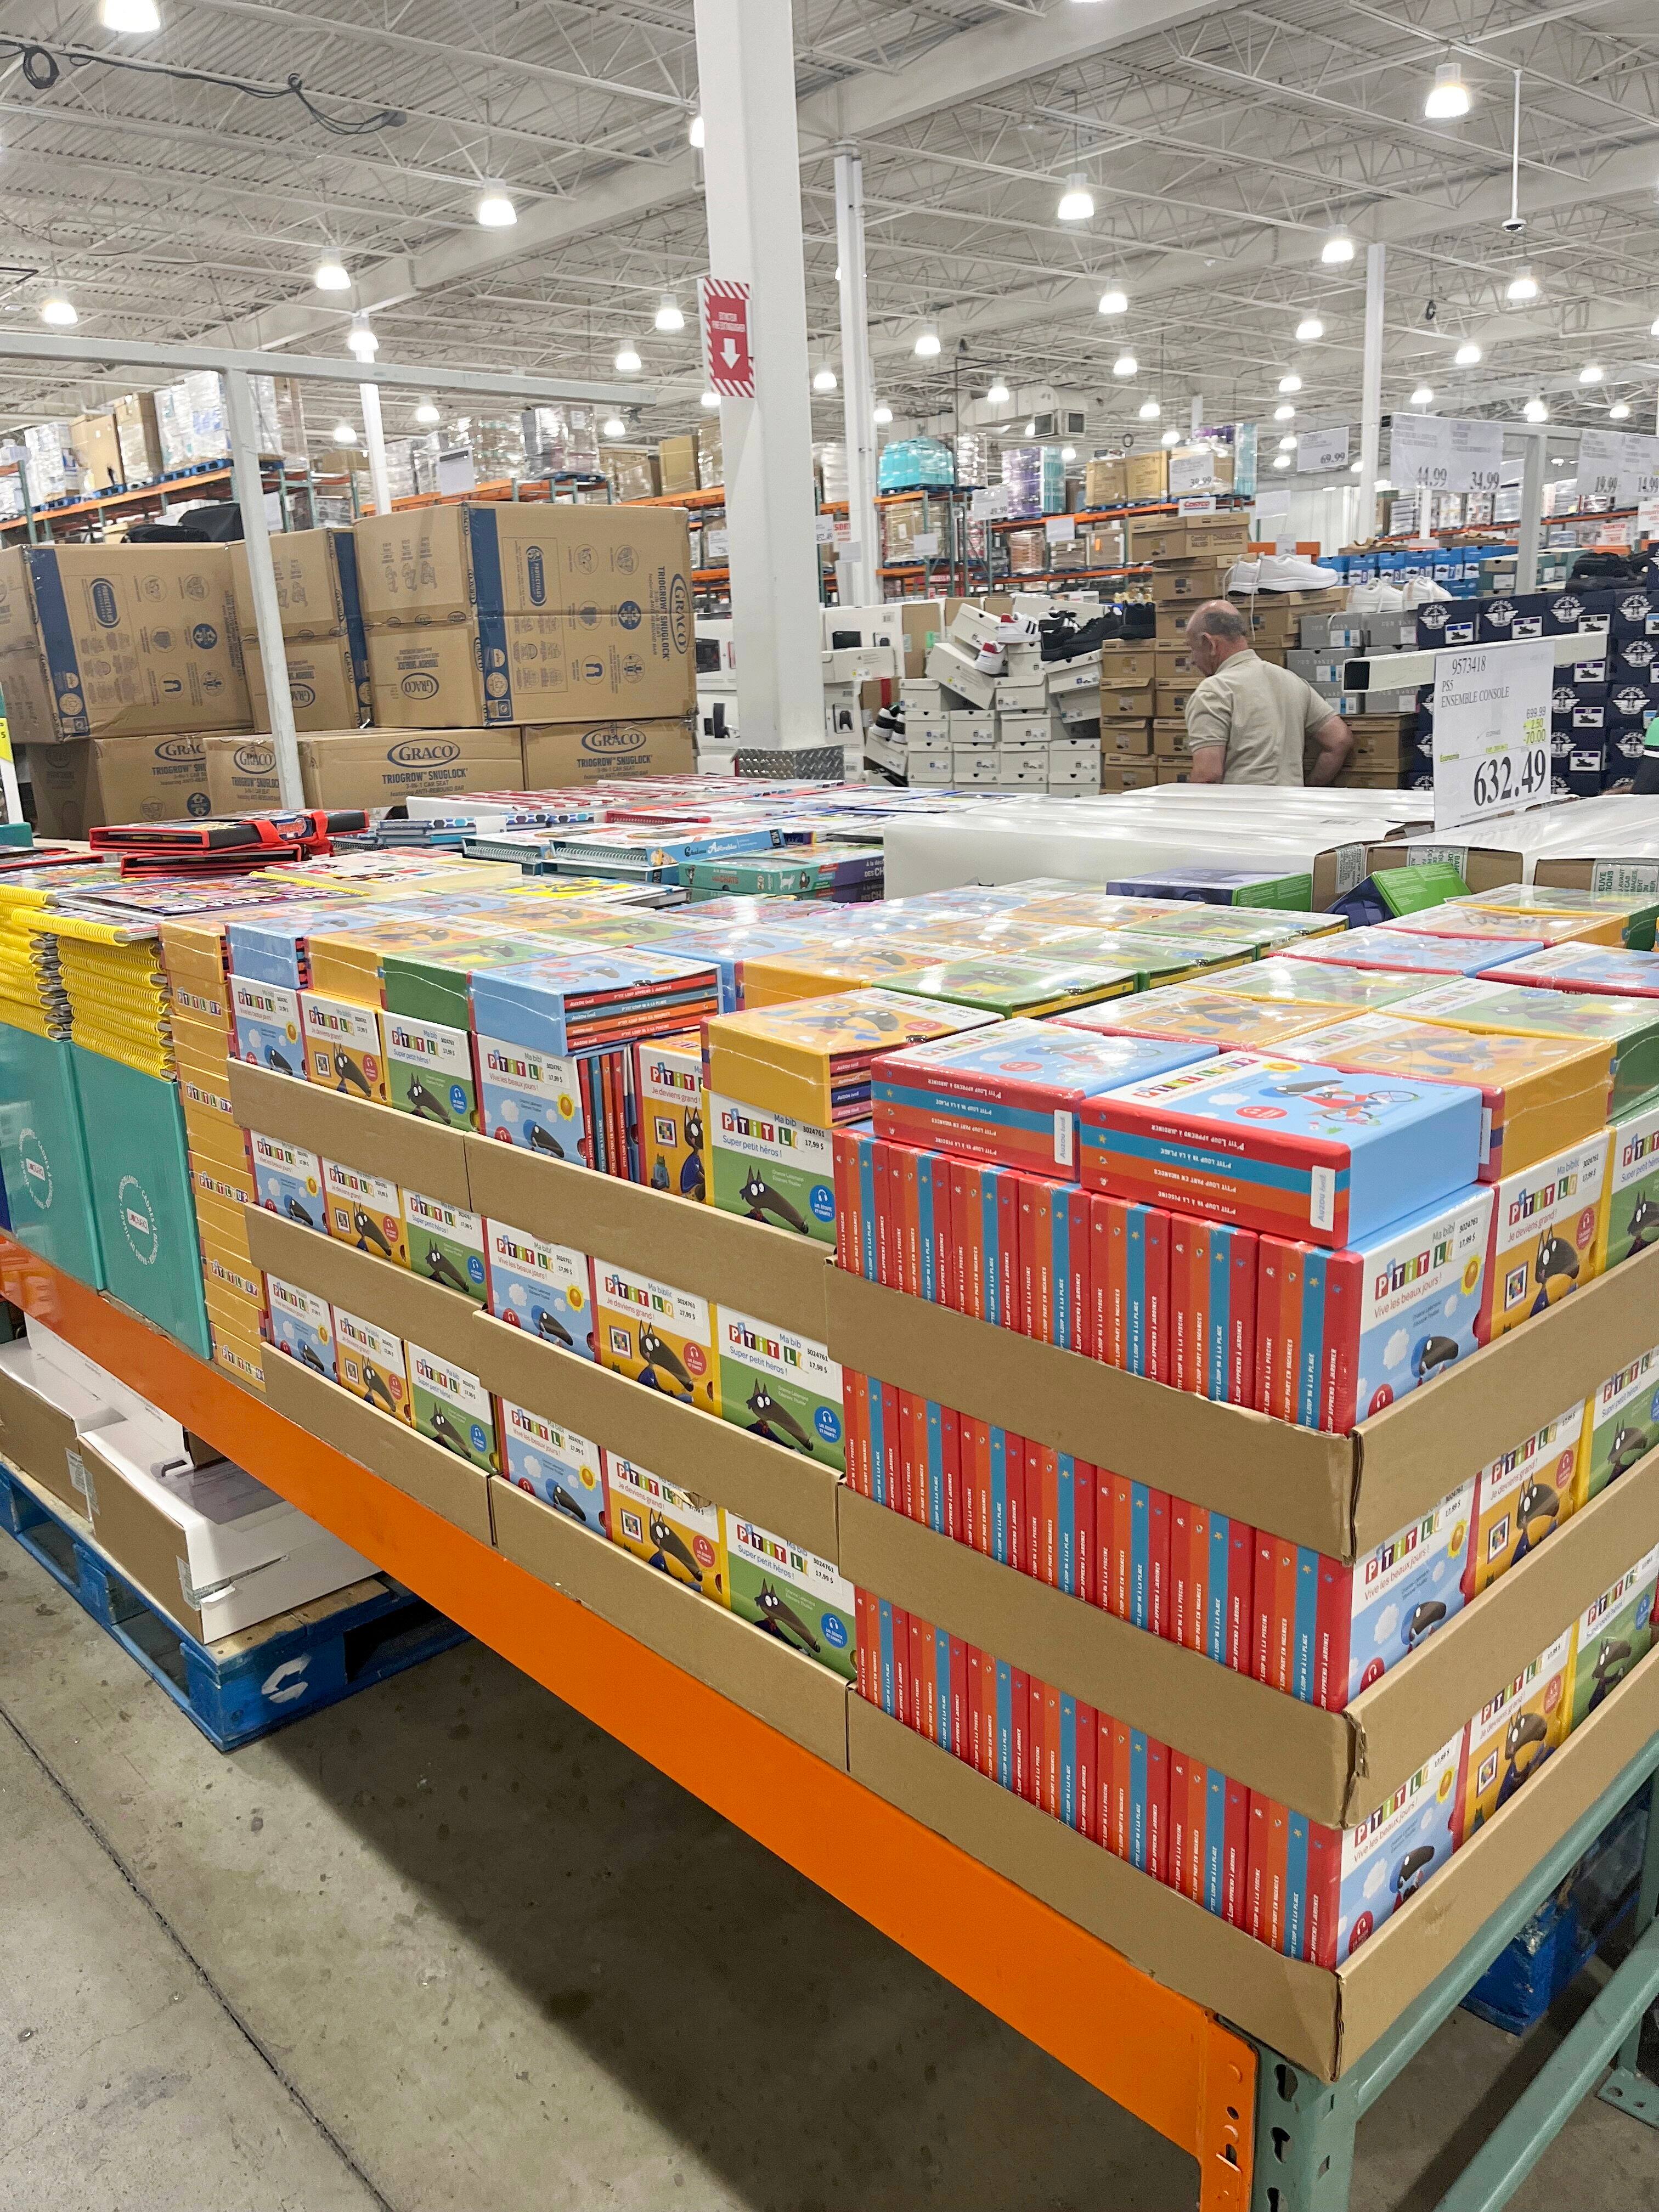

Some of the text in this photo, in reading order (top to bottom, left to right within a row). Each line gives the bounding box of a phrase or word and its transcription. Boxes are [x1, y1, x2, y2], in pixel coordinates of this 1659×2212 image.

[1321, 452, 1346, 465] 69.99
[1470, 471, 1499, 490] 34.99
[675, 585, 686, 646] GRACO
[1452, 656, 1486, 675] 9573418
[405, 680, 433, 693] GRACO
[1442, 680, 1454, 692] PS5
[1441, 686, 1509, 708] ENSEMBLE CONSOLE
[592, 733, 640, 746] GRACO
[165, 744, 205, 755] GRAC
[399, 745, 453, 760] GRACO
[240, 751, 272, 765] GRACO
[1474, 749, 1545, 806] 632.49
[508, 1078, 523, 1087] beaux
[774, 1114, 785, 1125] Ma
[802, 1125, 825, 1137] 3024761
[723, 1135, 779, 1157] Super petit héros
[805, 1139, 820, 1149] 17,99
[1516, 1223, 1538, 1238] deviens
[1538, 1212, 1555, 1229] grand
[1432, 1232, 1442, 1242] Ma
[498, 1256, 509, 1265] Vive
[516, 1263, 532, 1274] beaux
[532, 1270, 545, 1279] jours
[556, 1255, 572, 1265] 3024761
[677, 1297, 696, 1309] 3024761
[1374, 1276, 1439, 1318] Vive les beaux jours
[607, 1297, 652, 1319] Je deviens grand
[780, 1334, 789, 1343] Ma
[730, 1346, 785, 1374] Super petit héros
[807, 1348, 828, 1362] 3024761
[623, 1486, 646, 1502] deviens
[646, 1497, 662, 1509] grand
[738, 1545, 792, 1578] Super petit héros
[813, 1557, 834, 1573] 3024761
[1364, 1550, 1426, 1600] Vive les beaux jours
[1379, 1818, 1399, 1839] beaux
